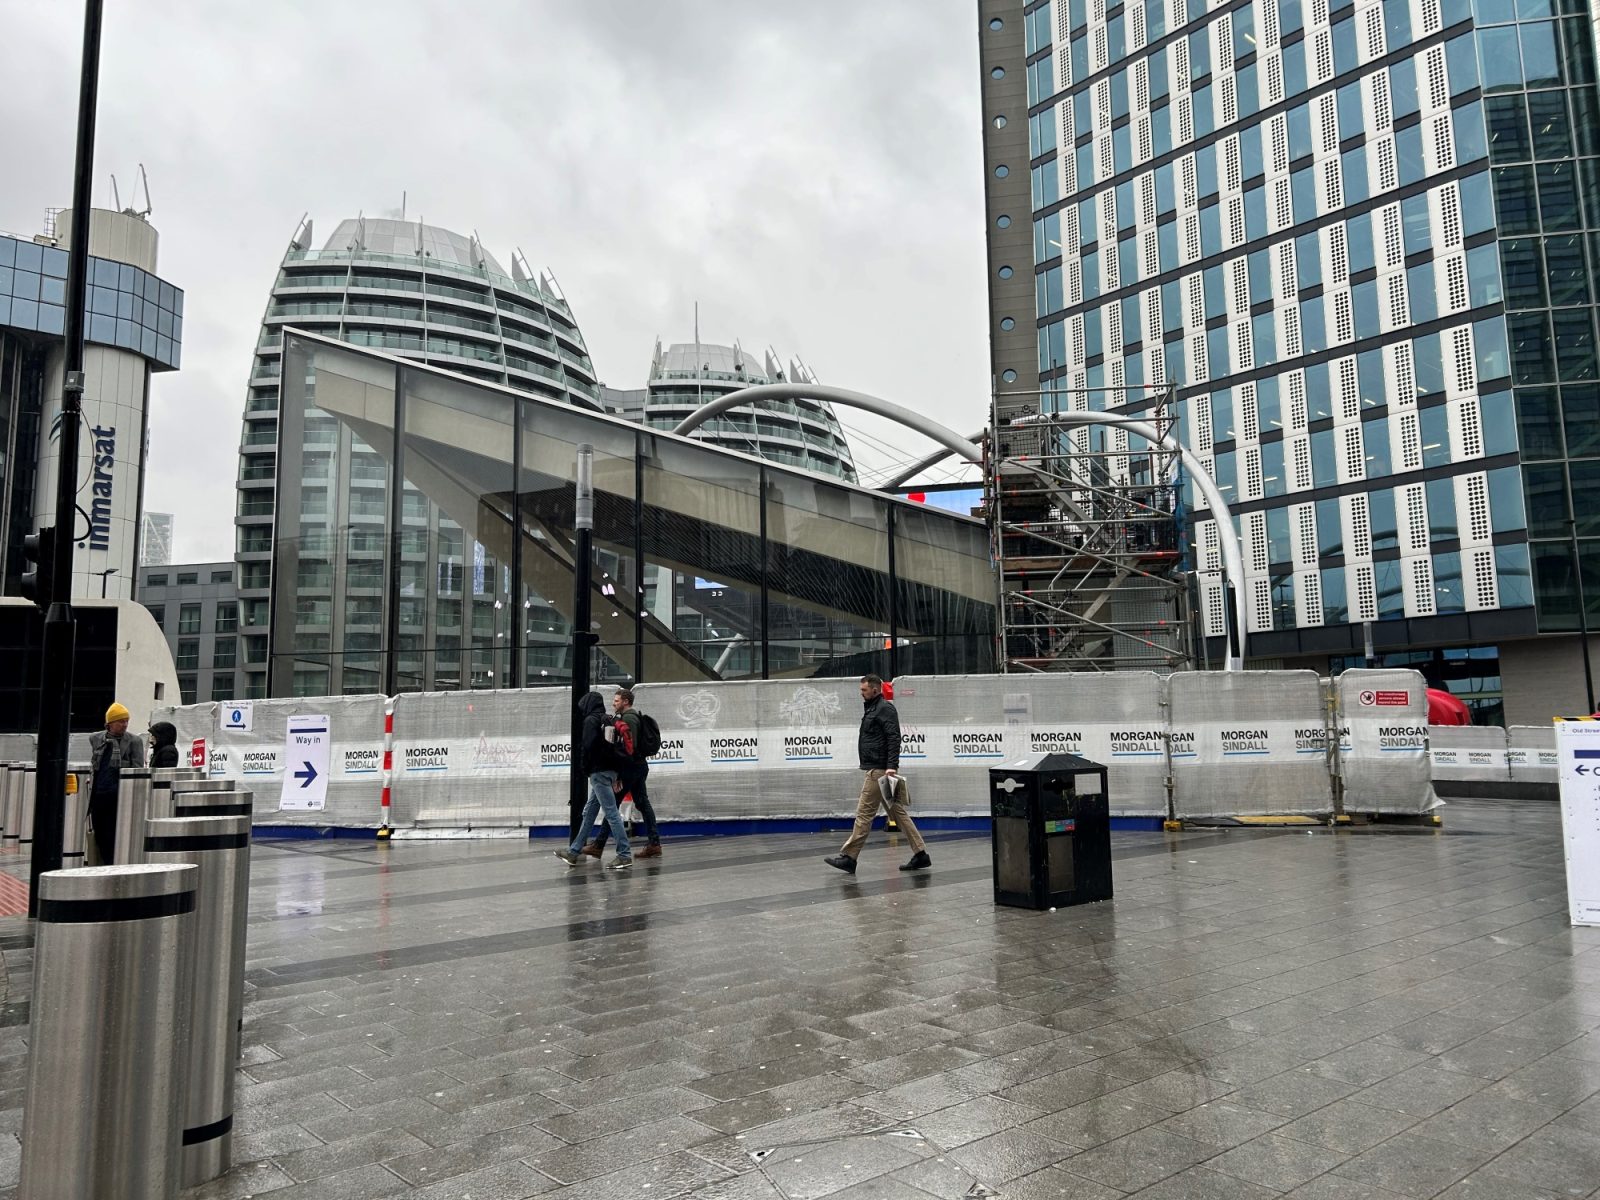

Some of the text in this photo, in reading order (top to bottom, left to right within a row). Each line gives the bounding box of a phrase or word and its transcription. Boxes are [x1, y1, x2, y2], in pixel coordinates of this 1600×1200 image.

[78, 425, 116, 551] inmarsat
[1110, 731, 1162, 741] MORGAN
[1221, 730, 1268, 740] MORGAN
[1295, 729, 1326, 738] MORG
[1379, 727, 1428, 736] MORGAN
[296, 736, 312, 746] Way
[784, 736, 832, 746] MORGAN
[901, 734, 925, 743] GAN
[953, 733, 1003, 743] MORGAN
[1031, 732, 1082, 742] MORGAN
[660, 740, 684, 749] GAN
[710, 738, 758, 748] MORGAN
[1222, 741, 1267, 751] SINDALL
[1380, 737, 1423, 747] SINDAL
[541, 744, 571, 753] MORG
[785, 747, 831, 756] SINDALL
[900, 744, 925, 754] DALL
[953, 744, 1002, 754] SINDALL
[1031, 743, 1081, 752] SINDALL
[1111, 742, 1161, 752] SINDALL
[1170, 744, 1194, 753] DALL
[244, 753, 276, 761] MORGAN
[345, 751, 378, 760] MORGAN
[405, 748, 448, 757] MORGAN
[711, 748, 756, 758] SINDALL
[210, 754, 227, 762] RGAN
[406, 758, 446, 767] SINDALL
[541, 754, 571, 763] SINDA
[242, 762, 274, 770] SINDALL
[345, 761, 377, 769] SINDALL
